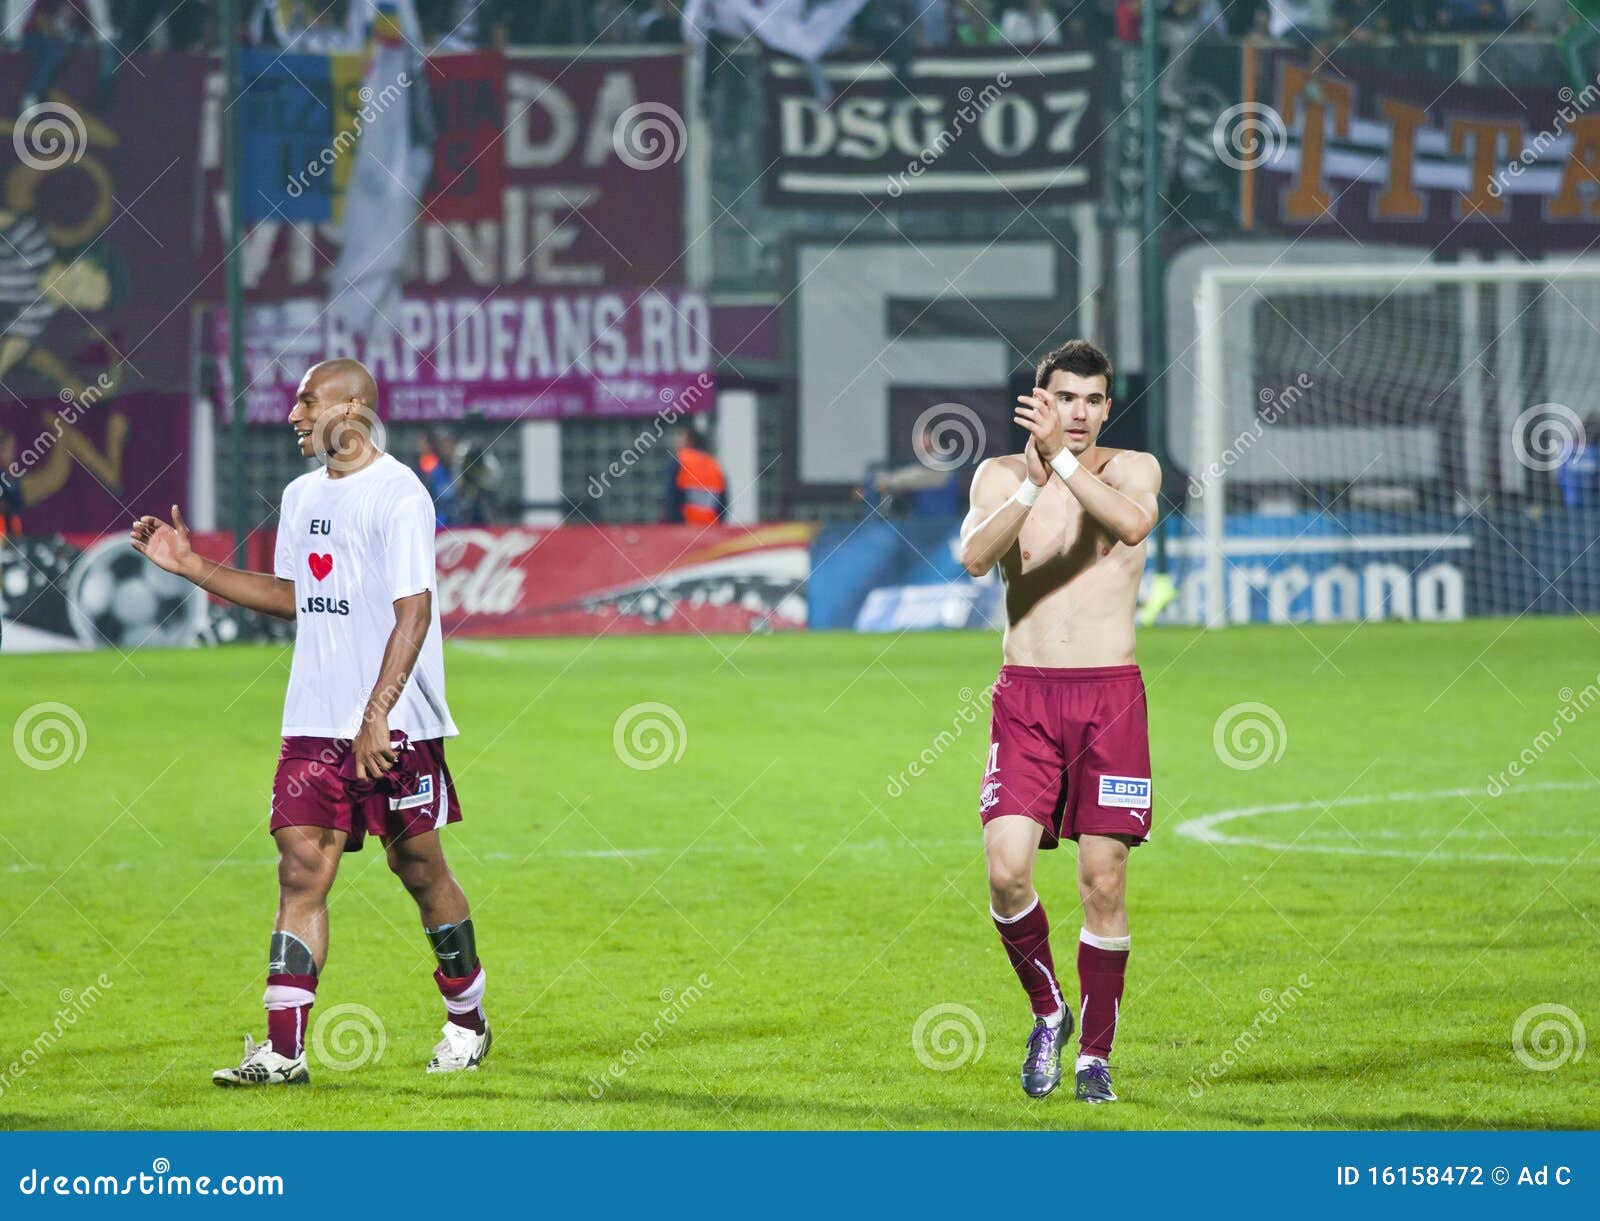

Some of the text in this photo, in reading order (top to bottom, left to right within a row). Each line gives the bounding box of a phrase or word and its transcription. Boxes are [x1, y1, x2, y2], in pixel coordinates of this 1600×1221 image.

[779, 90, 1090, 160] DSG 07
[310, 519, 331, 535] EU
